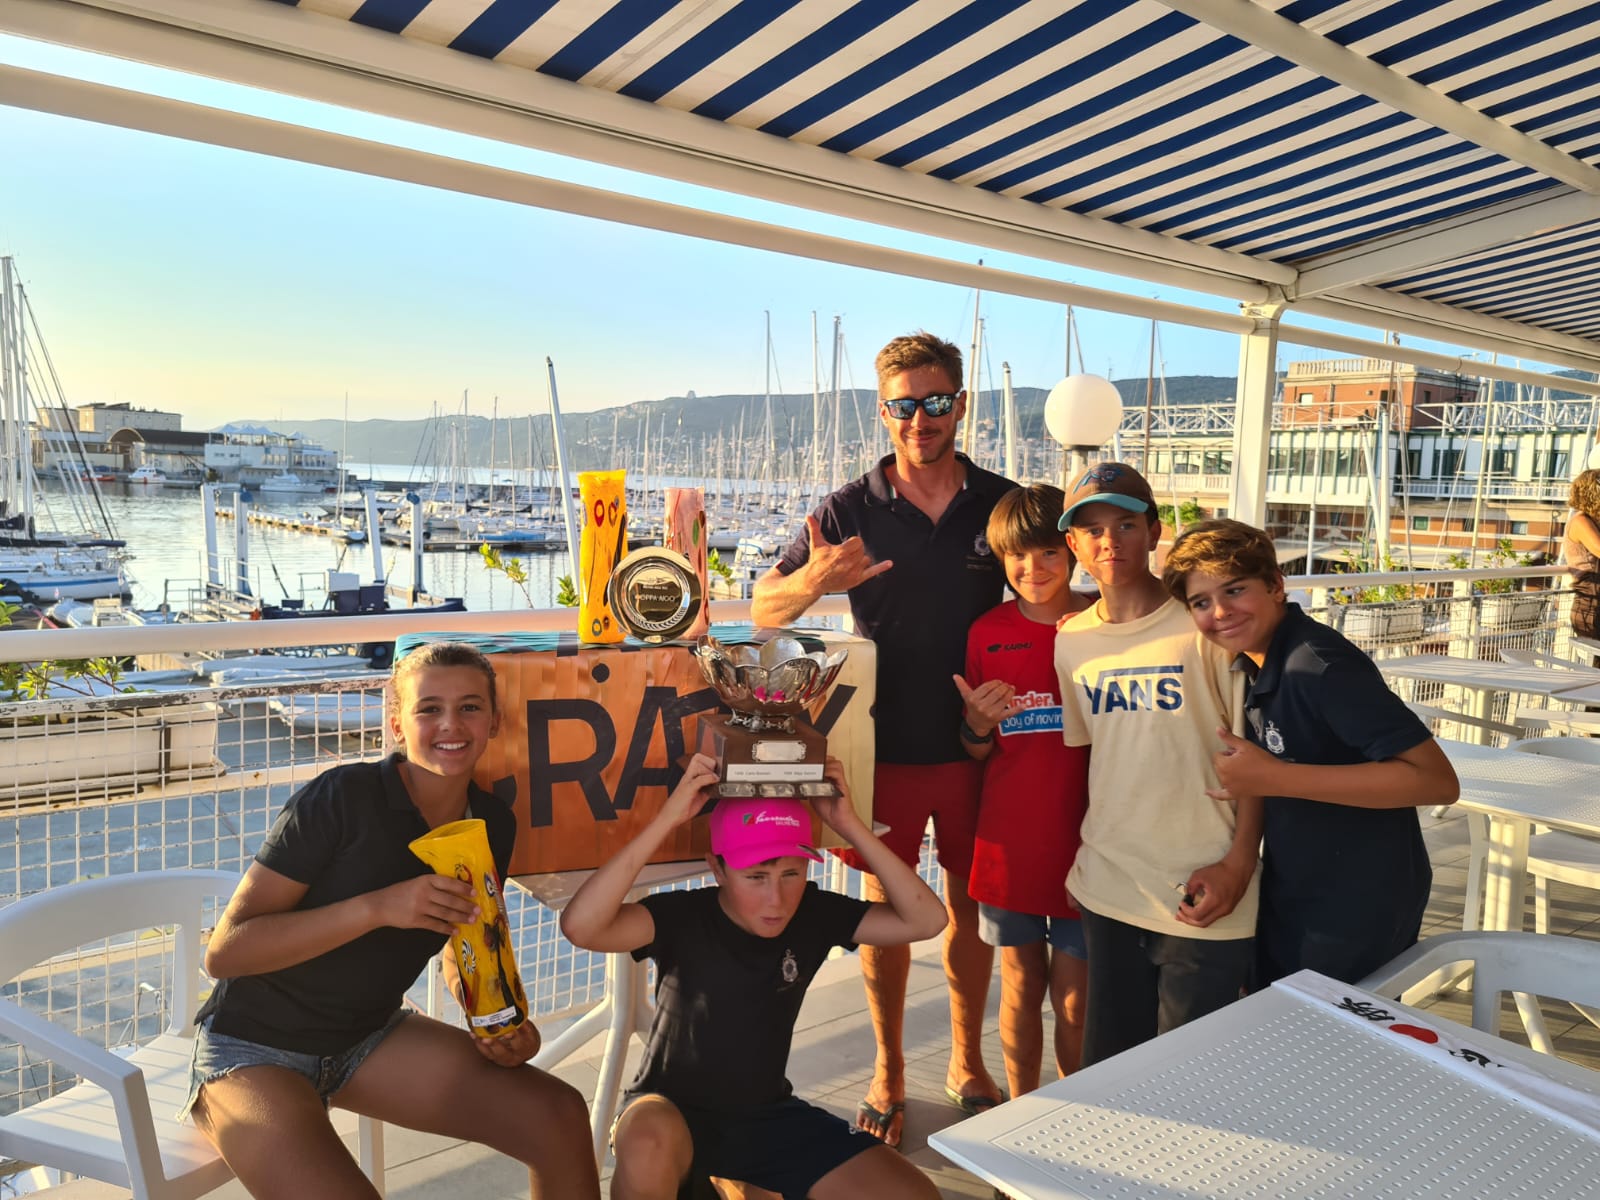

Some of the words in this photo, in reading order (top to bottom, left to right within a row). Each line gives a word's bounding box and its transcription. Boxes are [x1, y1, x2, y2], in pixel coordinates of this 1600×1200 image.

[1081, 665, 1184, 715] VANS
[1009, 692, 1051, 708] nder
[1035, 713, 1063, 726] movin
